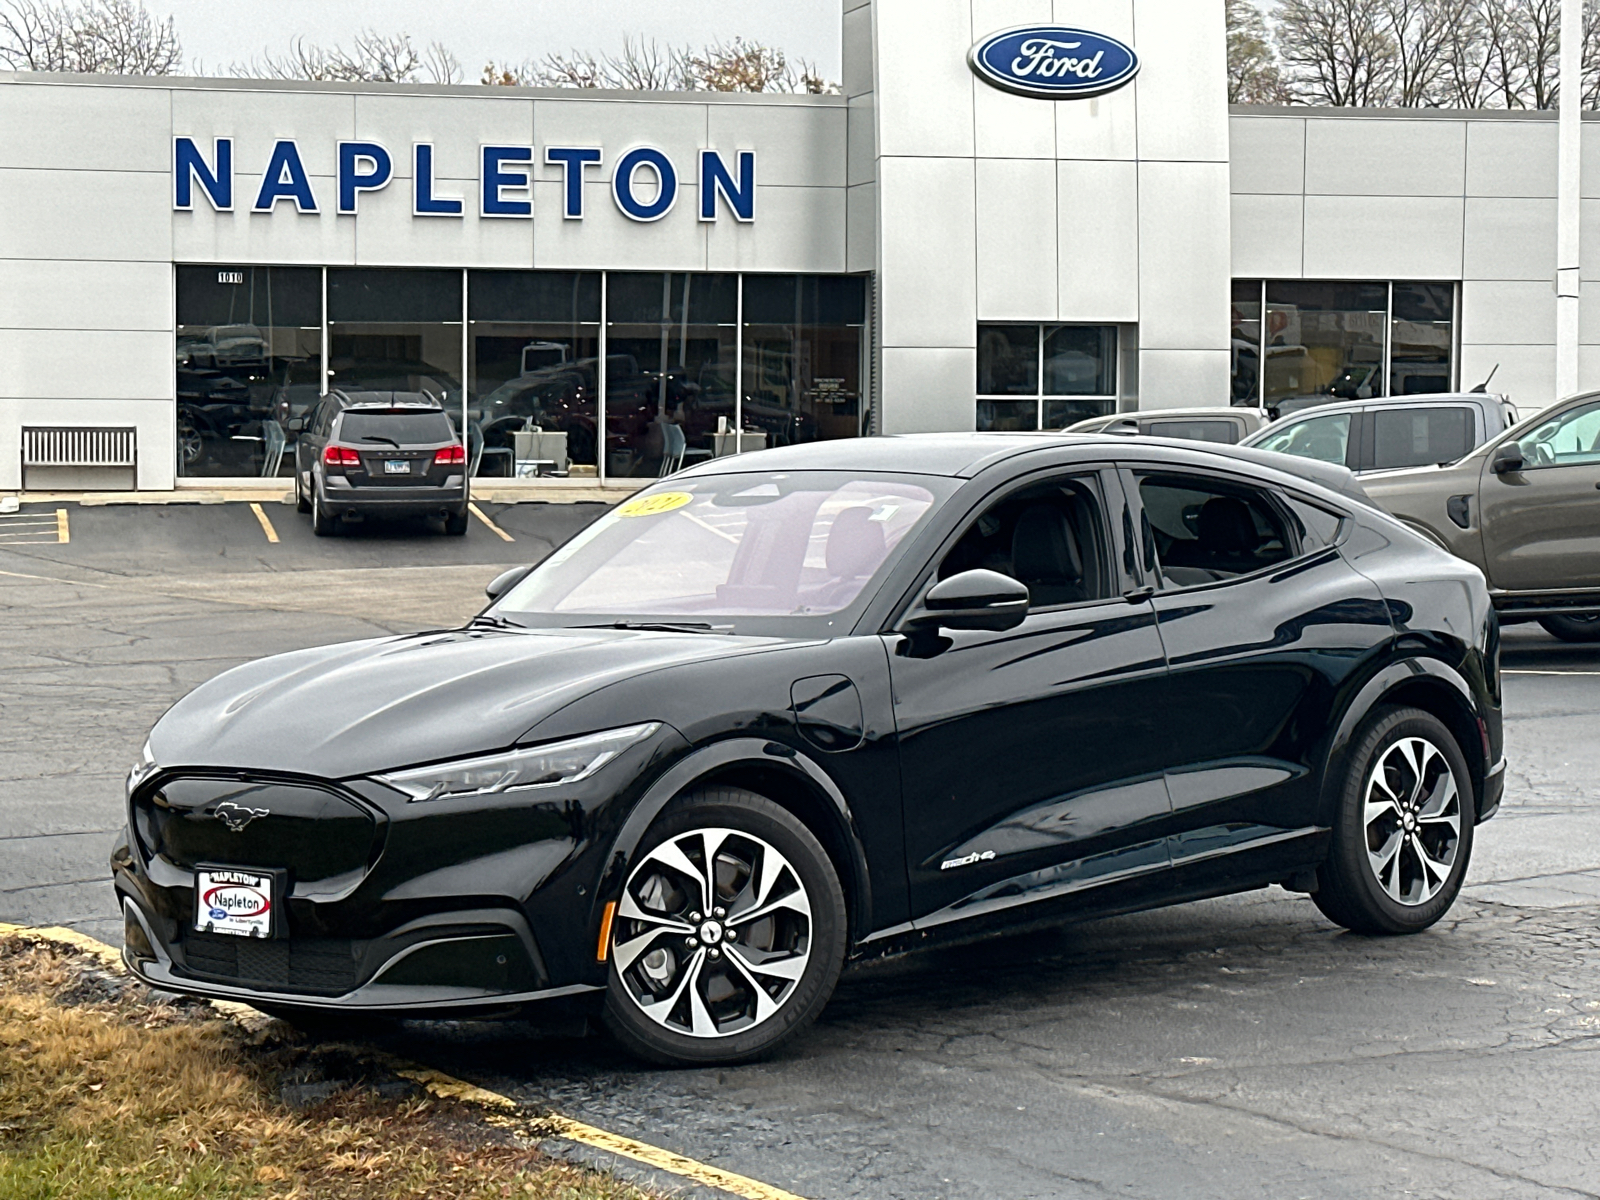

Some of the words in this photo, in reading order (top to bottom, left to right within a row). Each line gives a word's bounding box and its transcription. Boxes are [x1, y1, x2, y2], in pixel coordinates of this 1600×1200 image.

[1011, 38, 1104, 78] Ford
[172, 136, 756, 222] NAPLETON
[219, 271, 243, 283] 1010
[214, 891, 259, 910] Napleton
